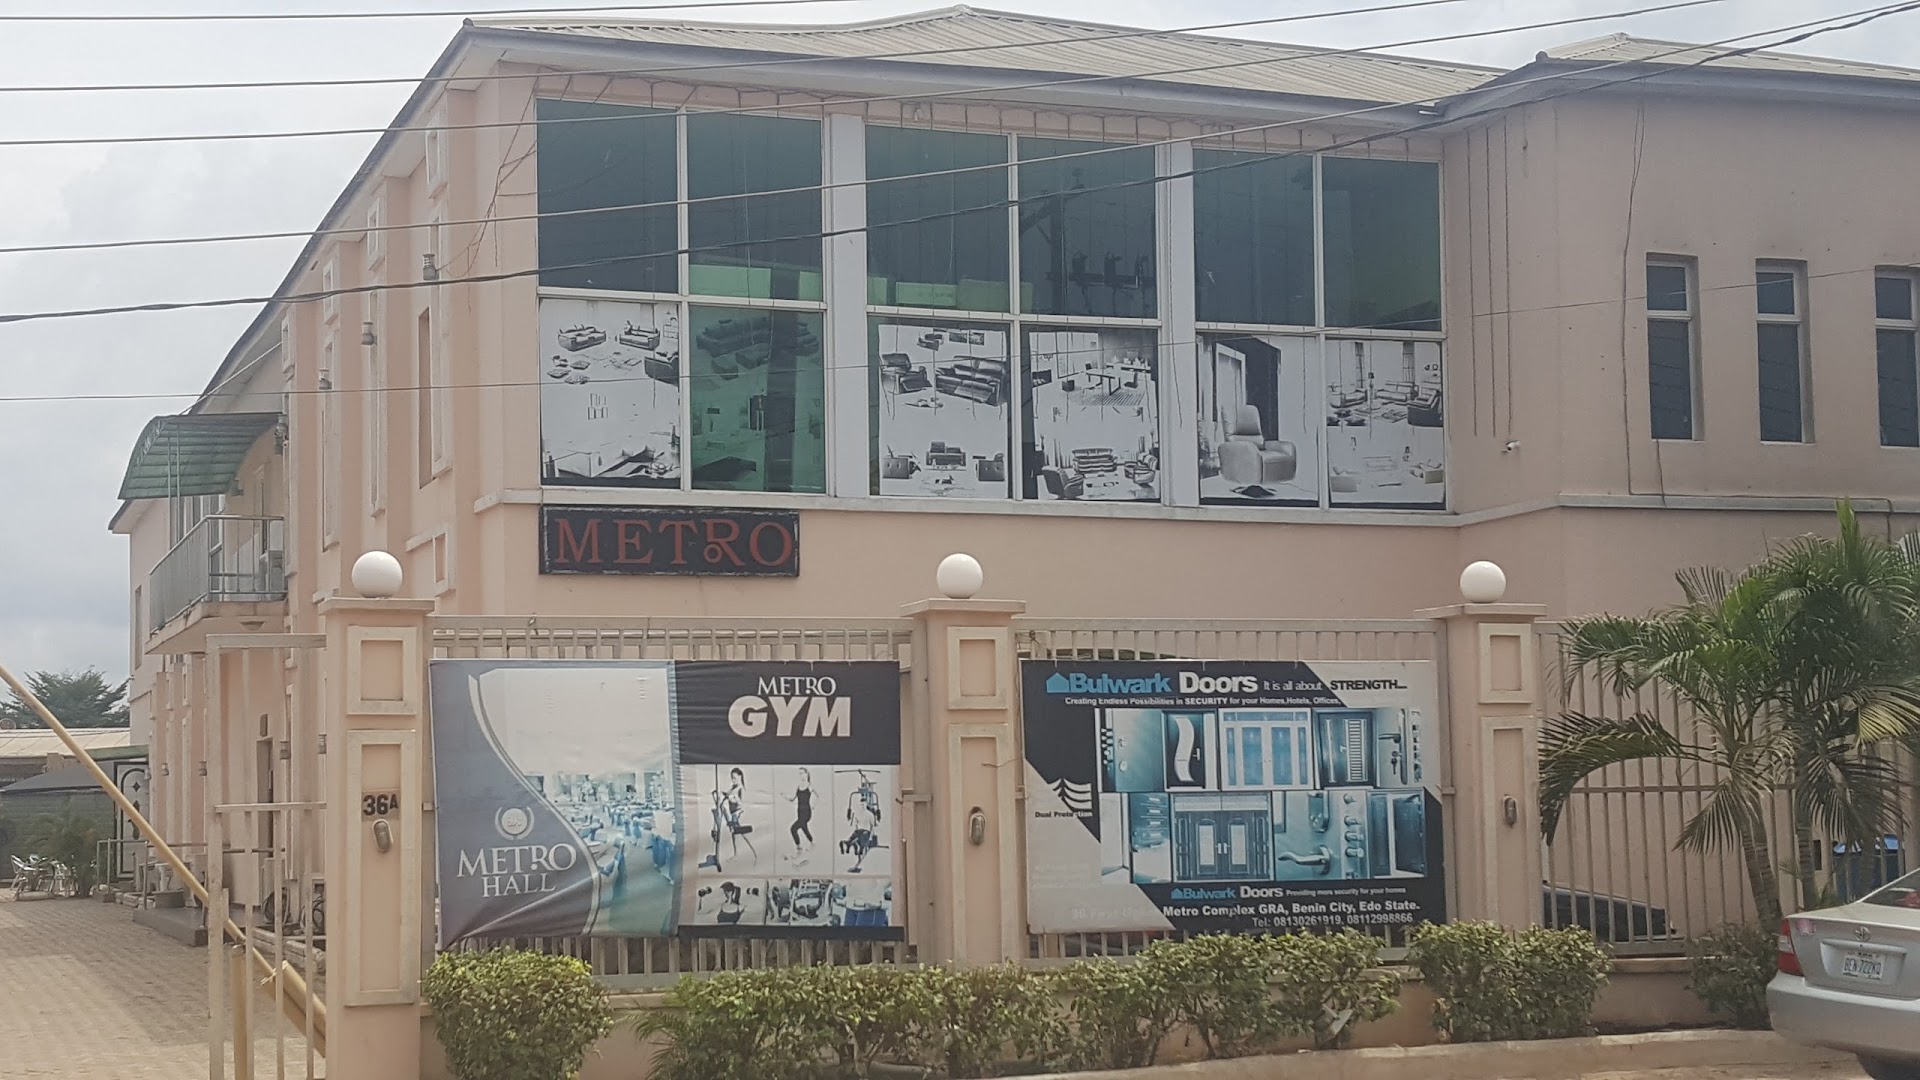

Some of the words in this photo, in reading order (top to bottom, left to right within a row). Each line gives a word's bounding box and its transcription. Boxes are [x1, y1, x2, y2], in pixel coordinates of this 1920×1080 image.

[554, 518, 793, 567] METRO
[757, 676, 836, 696] METRO
[1069, 672, 1172, 694] Bulwark
[1179, 671, 1258, 694] Doors
[1263, 681, 1271, 691] It
[1272, 681, 1281, 691] is
[1282, 681, 1293, 691] all
[1295, 681, 1323, 691] about
[1065, 697, 1097, 706] Creating
[1098, 697, 1129, 705] Endless
[1130, 697, 1175, 705] Possibilities
[1175, 697, 1184, 705] in
[1184, 697, 1228, 705] SECURITY
[1229, 697, 1240, 705] for
[1241, 698, 1258, 707] your
[728, 695, 851, 737] GYM
[363, 794, 399, 816] 36A
[456, 843, 577, 877] METRO
[481, 872, 556, 897] HALL
[1183, 887, 1237, 899] Bulwark
[1240, 885, 1284, 898] Doors
[1163, 905, 1199, 917] Metro
[1202, 904, 1256, 918] Complex
[1258, 903, 1289, 916] GRA,
[1292, 902, 1327, 914] Benin
[1329, 901, 1357, 914] City,
[1359, 901, 1382, 912] Edo
[1385, 900, 1420, 911] State.
[1252, 917, 1271, 928] Tel:
[1346, 912, 1414, 925] 08112998866
